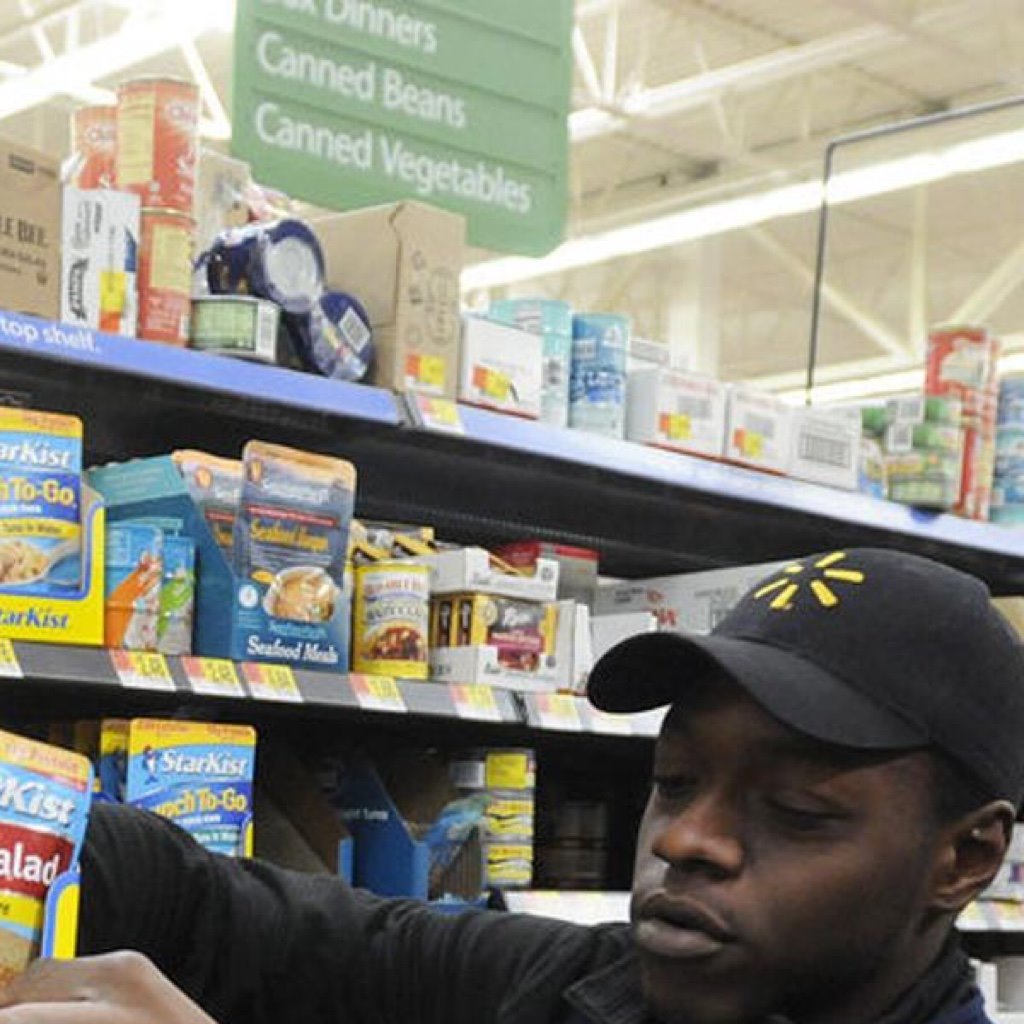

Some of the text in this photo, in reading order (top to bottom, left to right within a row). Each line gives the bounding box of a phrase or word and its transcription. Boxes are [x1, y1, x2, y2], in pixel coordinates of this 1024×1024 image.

[326, 0, 438, 54] Dinners
[257, 31, 465, 129] Canned Beans
[255, 102, 531, 213] Canned Vegetables
[1, 318, 39, 342] top
[10, 477, 75, 507] To-Go
[162, 749, 247, 776] StarKist
